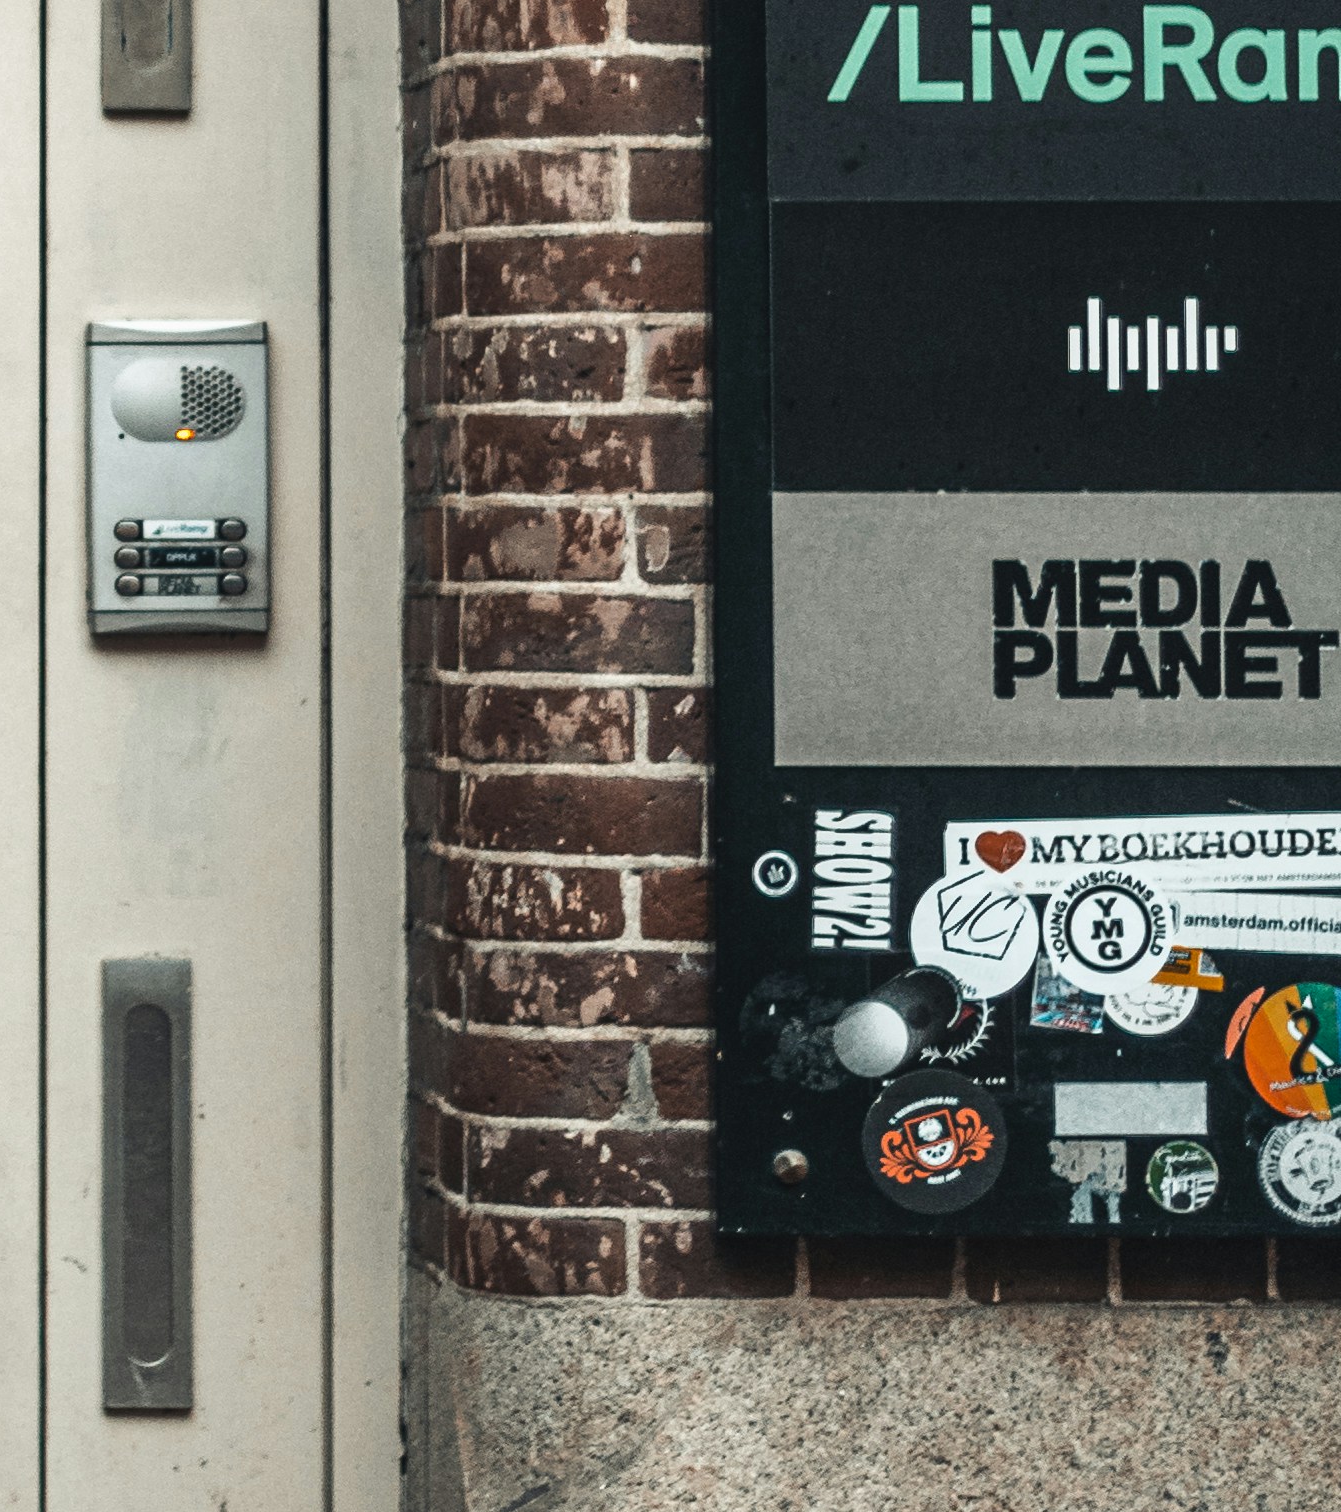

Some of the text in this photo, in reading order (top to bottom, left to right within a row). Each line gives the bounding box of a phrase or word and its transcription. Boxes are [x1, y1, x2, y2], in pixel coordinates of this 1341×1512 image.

[992, 559, 1292, 629] MEDIA
[992, 629, 1338, 700] PLANET
[958, 828, 1341, 865] I MY BOEKHOUDE
[1050, 869, 1167, 964] YOUNG MUSICIANS GUILD
